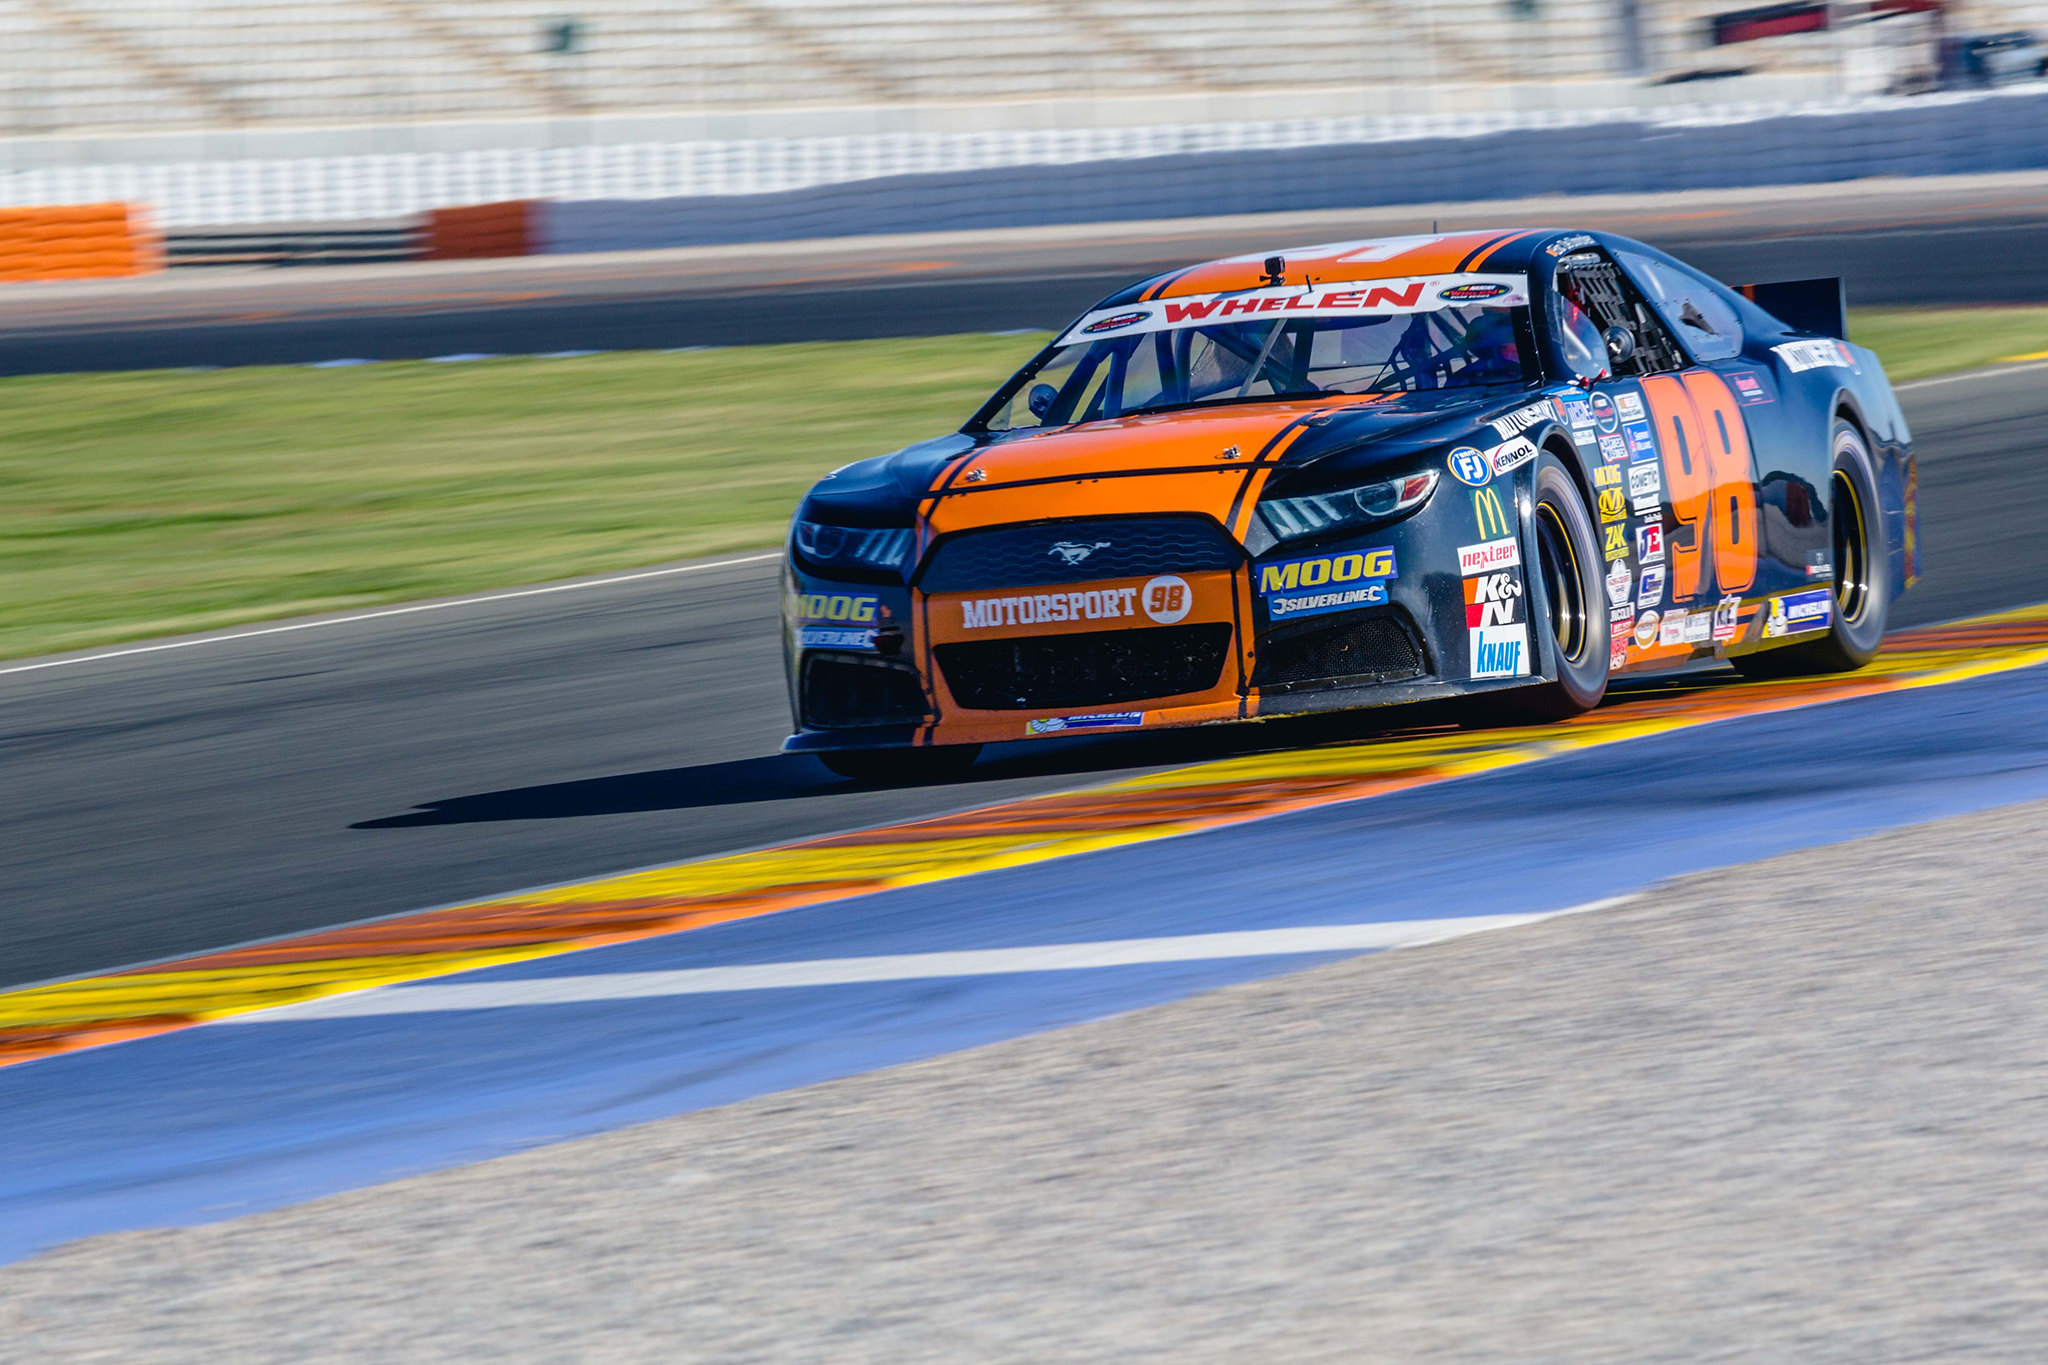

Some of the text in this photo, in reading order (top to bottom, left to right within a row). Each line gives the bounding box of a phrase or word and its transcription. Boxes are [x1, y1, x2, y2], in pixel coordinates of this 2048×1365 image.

[1164, 282, 1426, 324] WHELEN
[1458, 456, 1484, 481] FJ
[1495, 444, 1533, 469] KENNOL
[1593, 464, 1622, 487] MOOG
[1639, 369, 1758, 603] 98
[1605, 523, 1627, 551] ZAK
[1462, 543, 1516, 569] nexteer
[1261, 549, 1394, 593] MOOG
[962, 584, 1184, 628] MOTORSPORT 98
